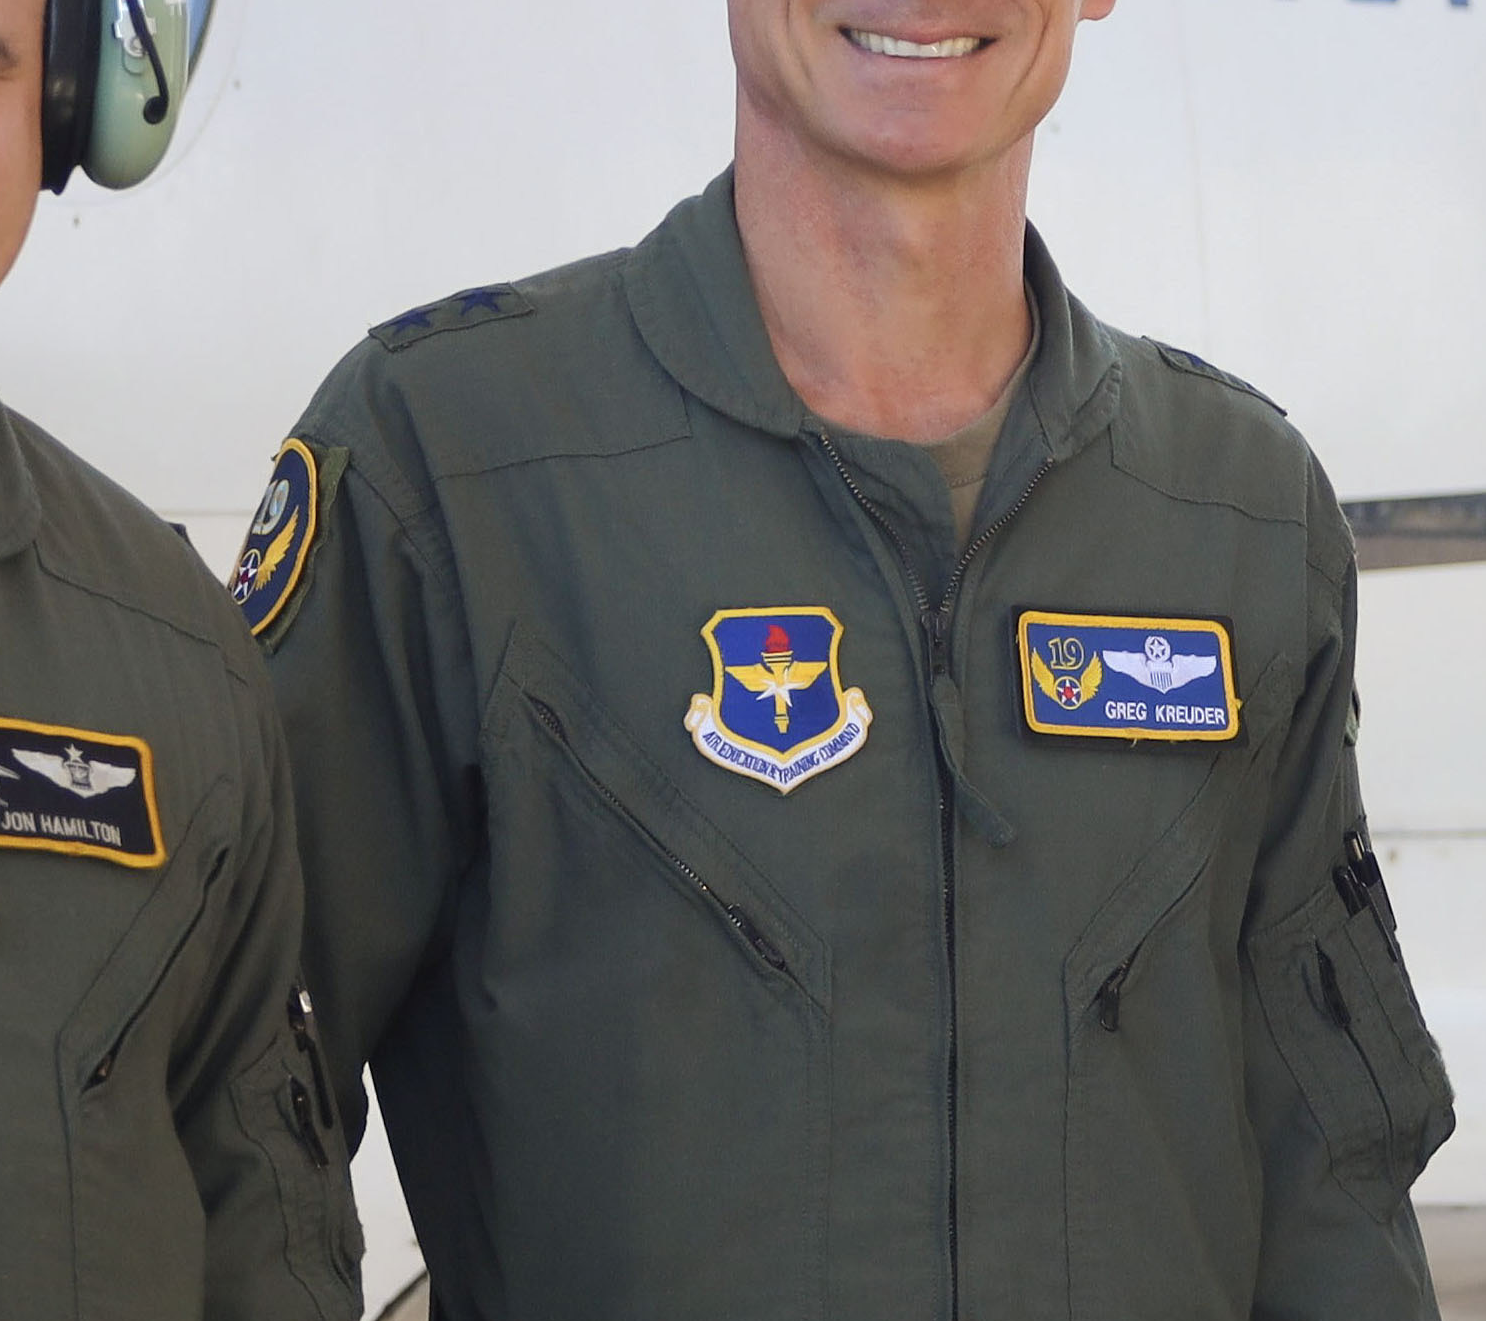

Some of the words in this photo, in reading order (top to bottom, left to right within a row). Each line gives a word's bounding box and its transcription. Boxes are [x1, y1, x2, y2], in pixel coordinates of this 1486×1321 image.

[1048, 637, 1084, 670] 19
[1105, 700, 1148, 721] GREG
[1155, 705, 1226, 725] KREUDER
[703, 731, 720, 751] AIR
[718, 745, 770, 775] EDUCATION
[774, 752, 820, 784] TRAINING
[819, 722, 860, 762] COMMAND
[1, 810, 37, 833] JON
[40, 814, 122, 847] HAMILTON
